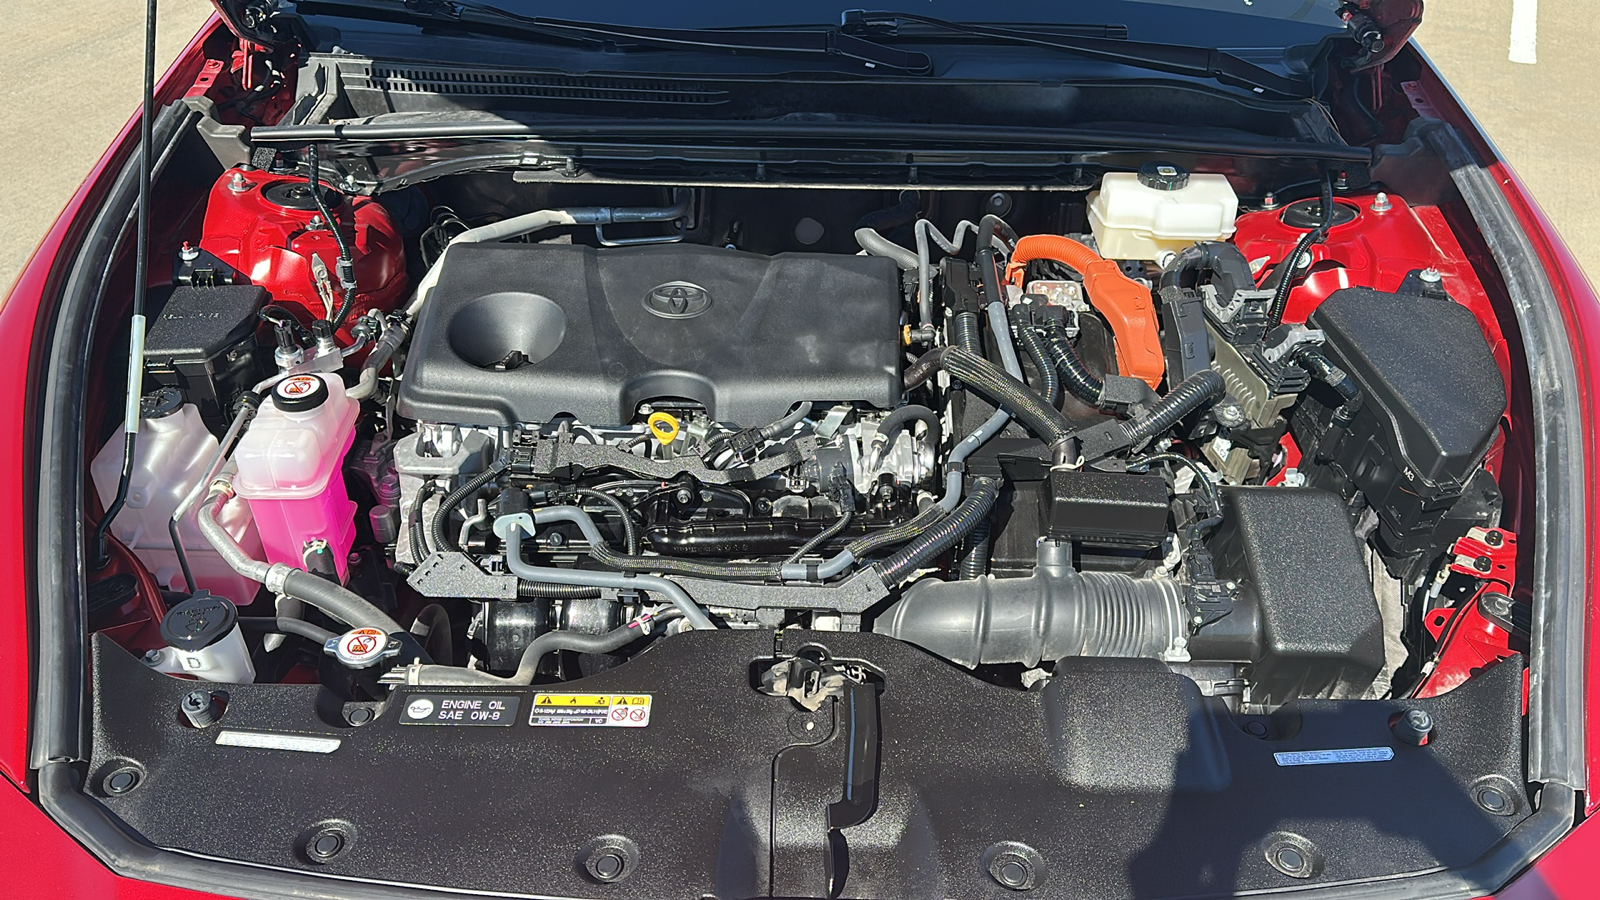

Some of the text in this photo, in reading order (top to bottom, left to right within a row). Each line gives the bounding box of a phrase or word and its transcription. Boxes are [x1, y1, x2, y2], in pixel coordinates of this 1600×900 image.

[441, 700, 506, 710] ENGINE OIL
[438, 711, 463, 719] SAE
